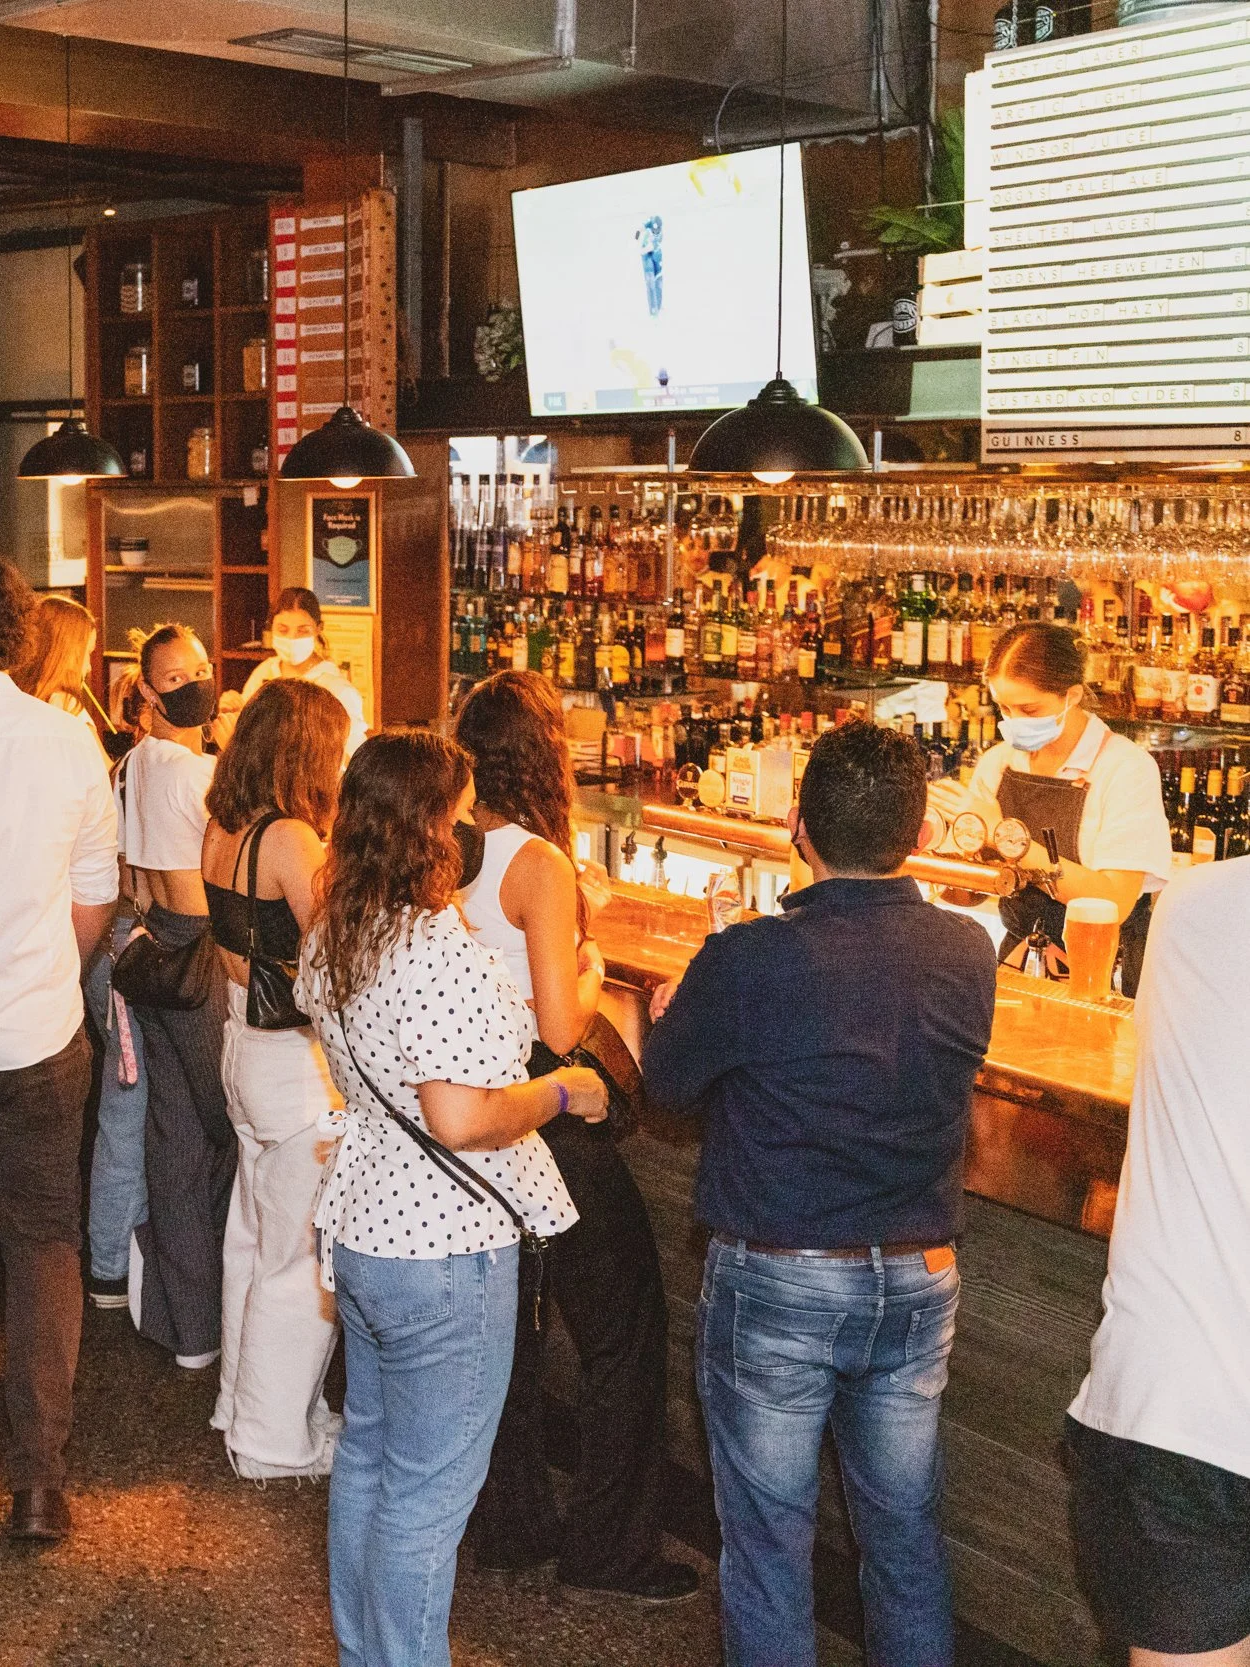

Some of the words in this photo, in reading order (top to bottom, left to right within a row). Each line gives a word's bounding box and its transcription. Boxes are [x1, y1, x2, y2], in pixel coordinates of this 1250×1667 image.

[997, 58, 1063, 81] ARCTIC
[1081, 44, 1140, 66] LAGER
[994, 101, 1060, 121] ARCTIC
[1079, 88, 1137, 108] LIGHT
[992, 141, 1071, 163] WINDSOR
[1090, 129, 1147, 150] JUICE
[992, 187, 1047, 204] OGGYS
[1064, 178, 1110, 194] PALE
[1128, 171, 1163, 186] ALE
[993, 225, 1070, 245] SHELTER
[1093, 217, 1151, 234] LAGER
[991, 269, 1058, 287] OGDENS
[1077, 256, 1201, 277] HEFEWEIZEN
[991, 309, 1044, 327] BLACK
[1068, 307, 1101, 321] HOP
[1118, 302, 1165, 317] HAZY
[990, 353, 1053, 367] SINGLE
[1072, 350, 1105, 362] FIN
[1236, 341, 1244, 353] 8
[988, 393, 1065, 407] CUSTARD
[1078, 391, 1111, 404] &CO
[1131, 385, 1191, 402] CIDER
[1233, 385, 1241, 398] 8
[991, 434, 1080, 448] GUINNESS
[1233, 430, 1242, 442] 8
